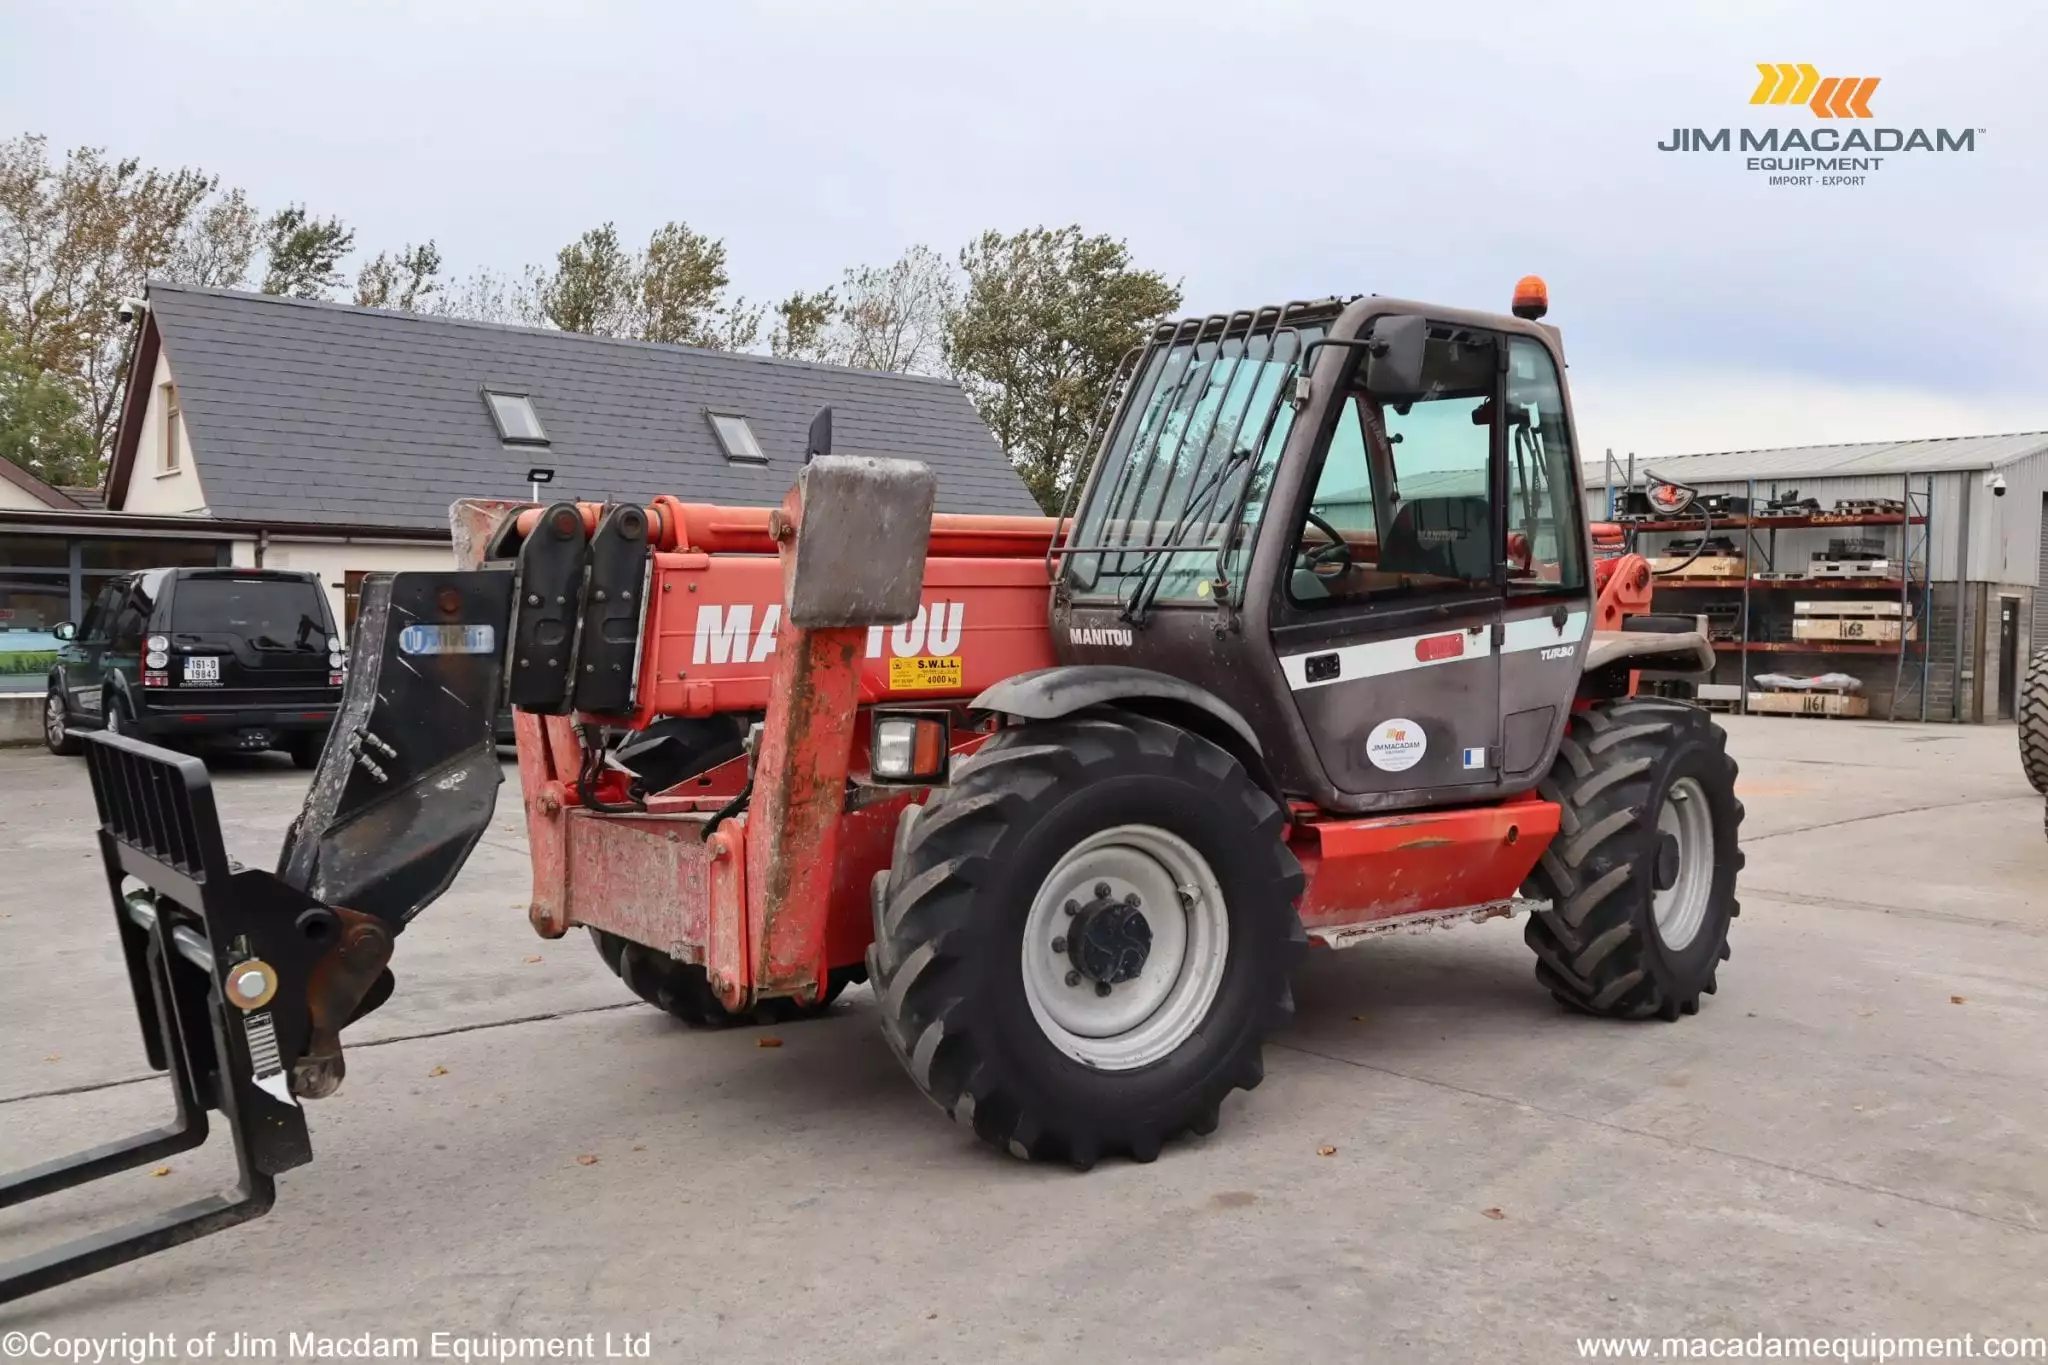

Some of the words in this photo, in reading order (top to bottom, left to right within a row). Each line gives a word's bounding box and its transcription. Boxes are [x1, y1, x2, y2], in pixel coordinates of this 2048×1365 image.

[1069, 628, 1133, 647] MANITOU
[1540, 645, 1574, 661] TURBO
[191, 669, 217, 679] 19843
[1803, 695, 1826, 712] 1161
[1384, 741, 1420, 750] MACADAM
